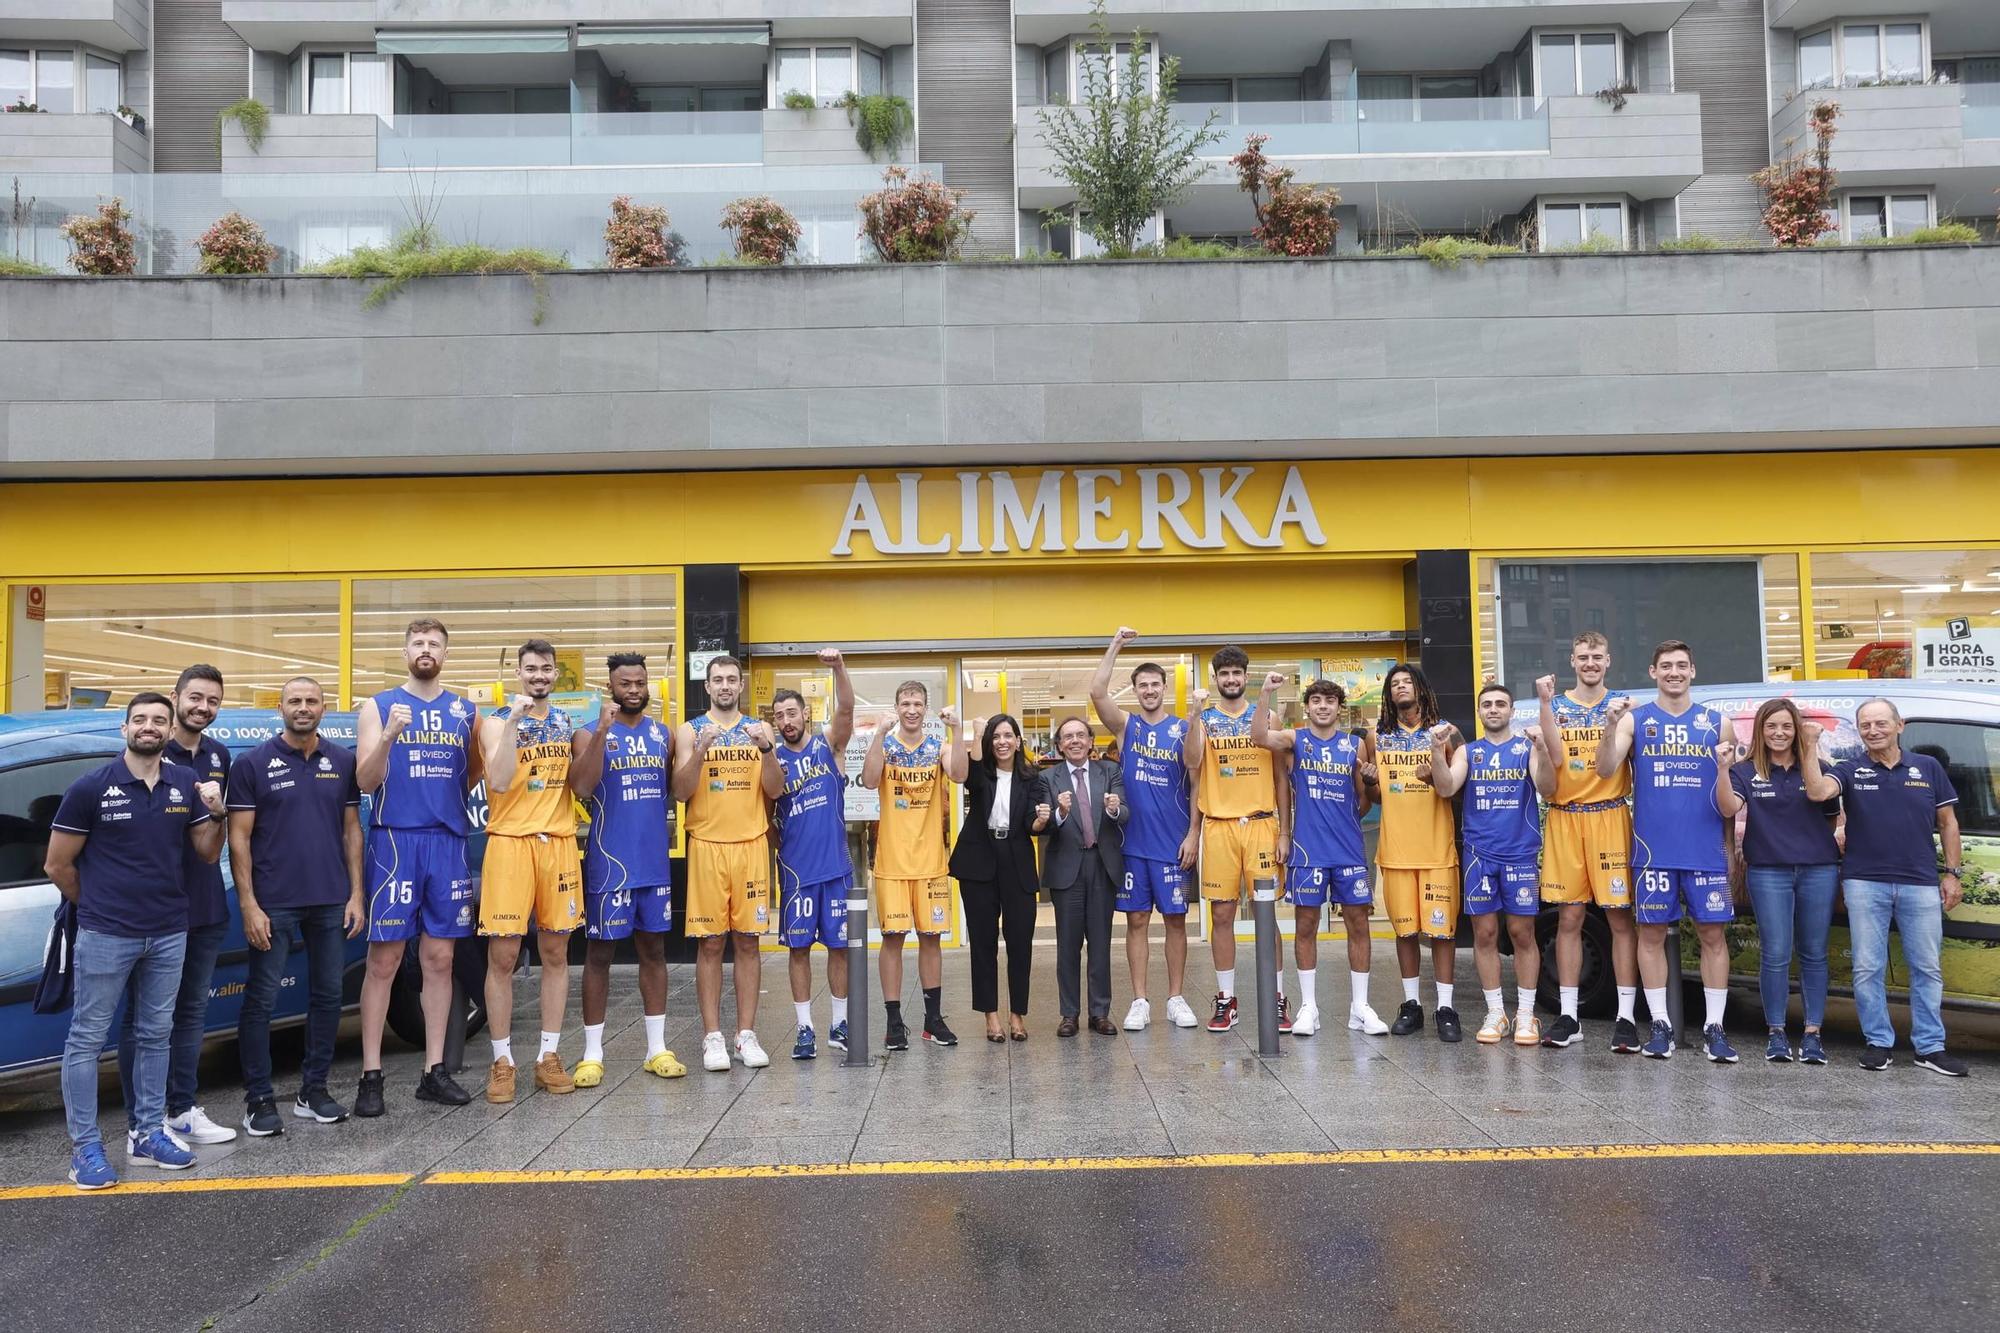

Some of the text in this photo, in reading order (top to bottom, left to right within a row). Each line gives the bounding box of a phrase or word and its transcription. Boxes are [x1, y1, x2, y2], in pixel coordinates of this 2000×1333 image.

[830, 465, 1328, 556] ALIMERKA
[1923, 644, 1983, 667] 1 HORA
[1939, 656, 1994, 667] GRATIS
[983, 680, 989, 688] 2
[420, 709, 442, 731] 15
[236, 727, 274, 740] 100%
[396, 730, 464, 748] ALIMERKA
[1147, 731, 1157, 748] 6
[1664, 724, 1688, 744] 55
[625, 735, 647, 755] 34
[1642, 744, 1712, 758] ALIMERKA
[421, 750, 452, 759] OVIEDO
[704, 749, 760, 761] LIMERKA
[1321, 746, 1332, 763] 5
[1381, 753, 1432, 765] ALIMERK
[1489, 752, 1501, 769] 4
[427, 765, 453, 774] Asturias
[719, 766, 749, 774] OVIEDO
[795, 756, 812, 777] 10
[1665, 761, 1698, 769] OVIEDO
[632, 773, 659, 781] OVIEDO
[887, 769, 936, 782] ALIMERK
[1318, 776, 1344, 787] OVIEDO
[1673, 775, 1701, 784] Asturias
[1486, 785, 1517, 793] OVIEDO
[1125, 872, 1134, 890] 6
[1314, 868, 1323, 885] 5
[1481, 876, 1491, 894] 4
[1645, 871, 1669, 892] 55
[388, 880, 413, 904] 15
[612, 889, 632, 907] 34
[794, 897, 813, 917] 10
